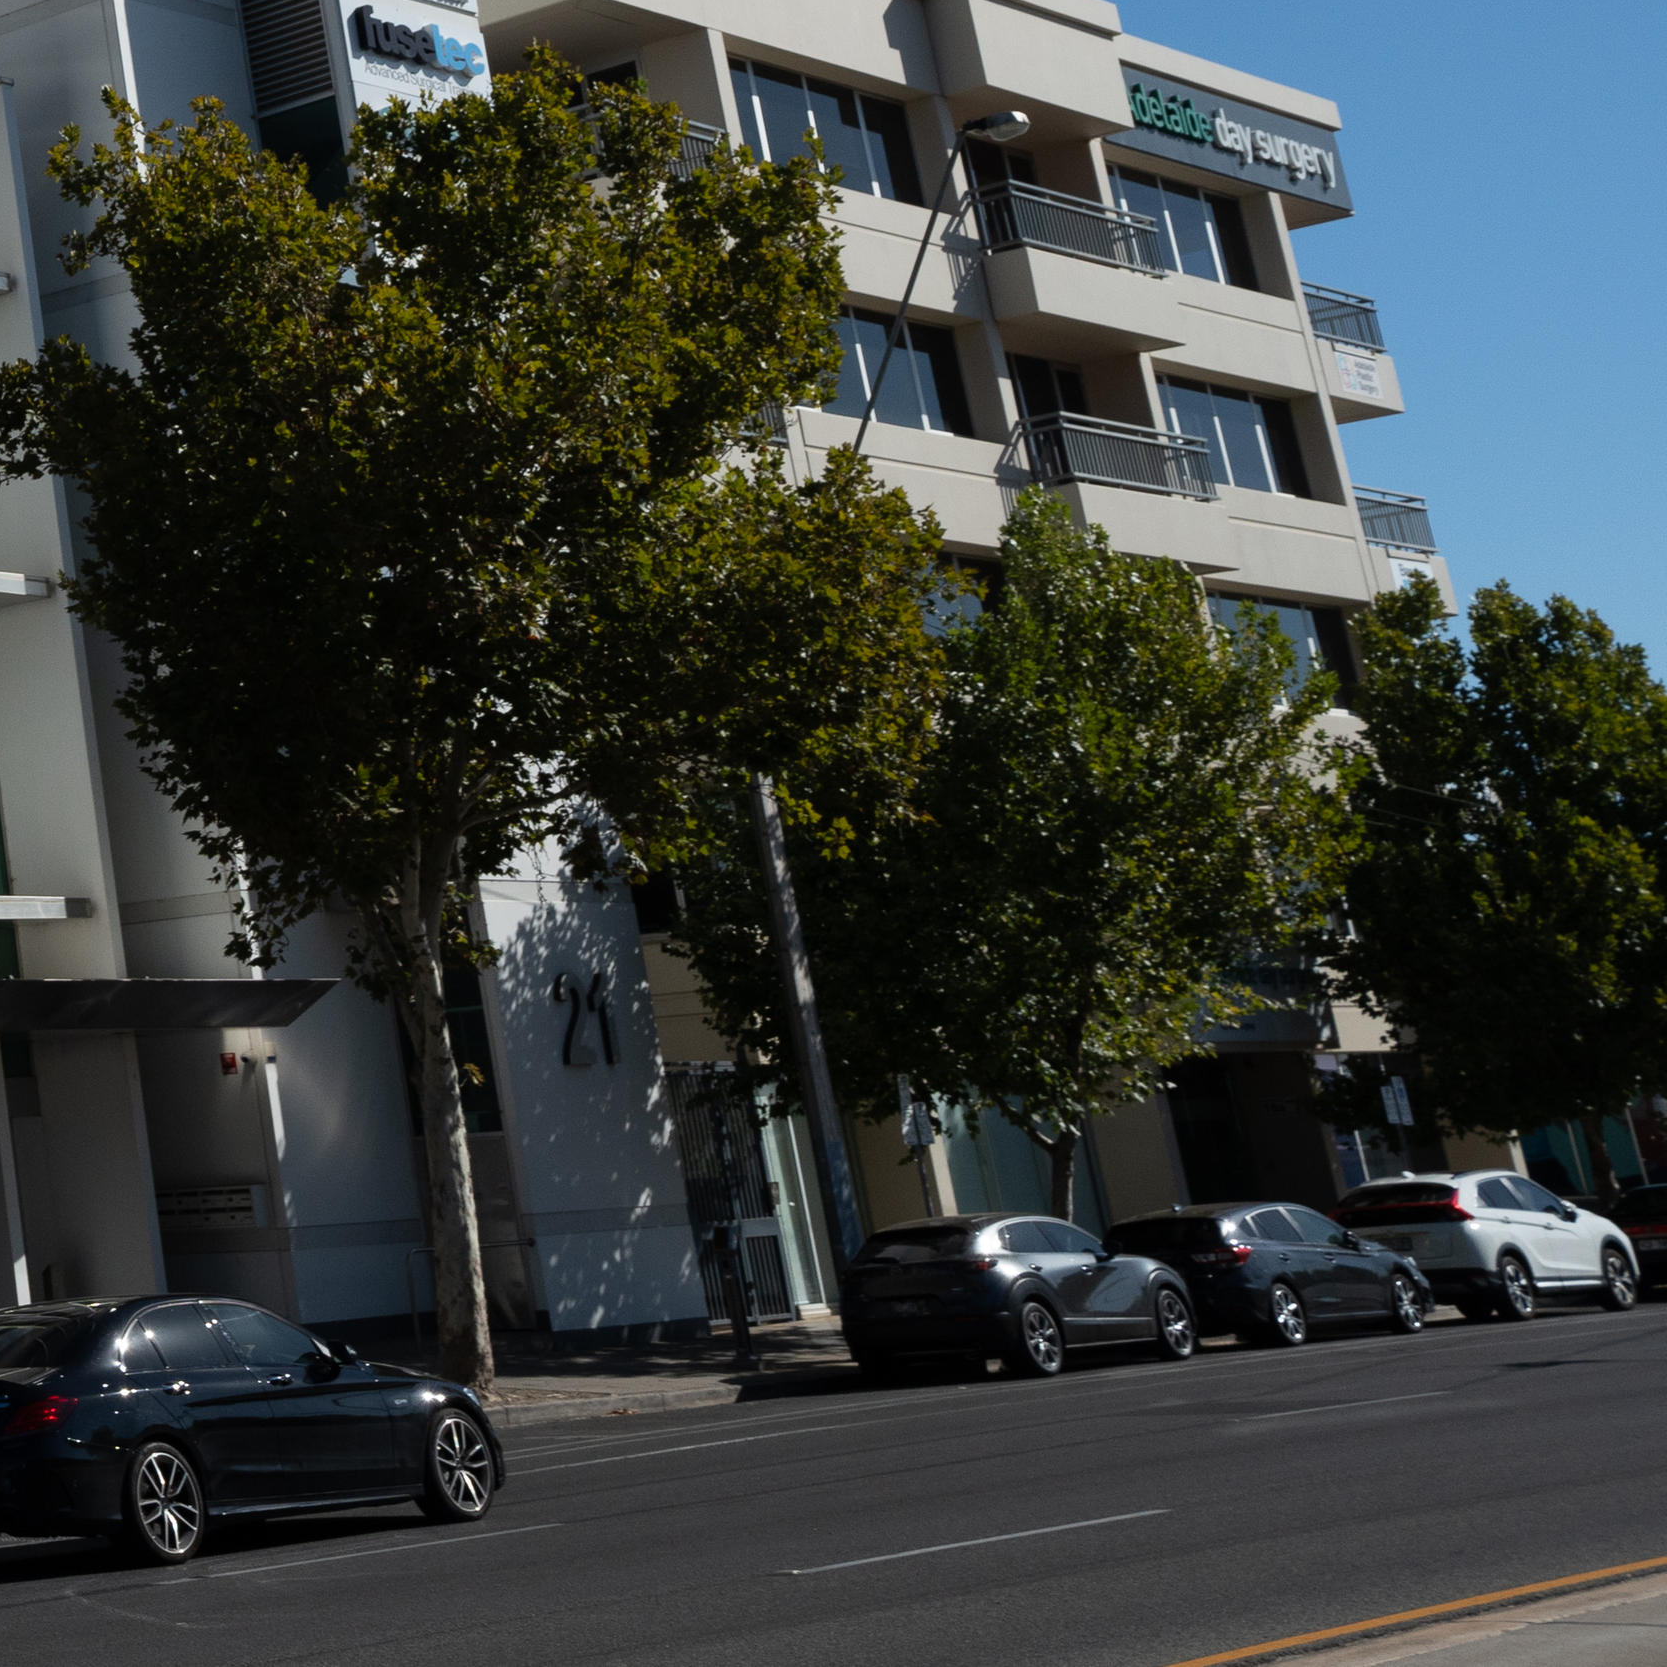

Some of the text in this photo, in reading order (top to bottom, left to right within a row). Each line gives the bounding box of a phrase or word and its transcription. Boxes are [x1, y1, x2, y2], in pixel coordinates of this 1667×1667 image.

[364, 63, 411, 84] Advanced
[410, 71, 447, 95] Surgical
[1214, 108, 1254, 164] day
[1254, 130, 1337, 188] surgery
